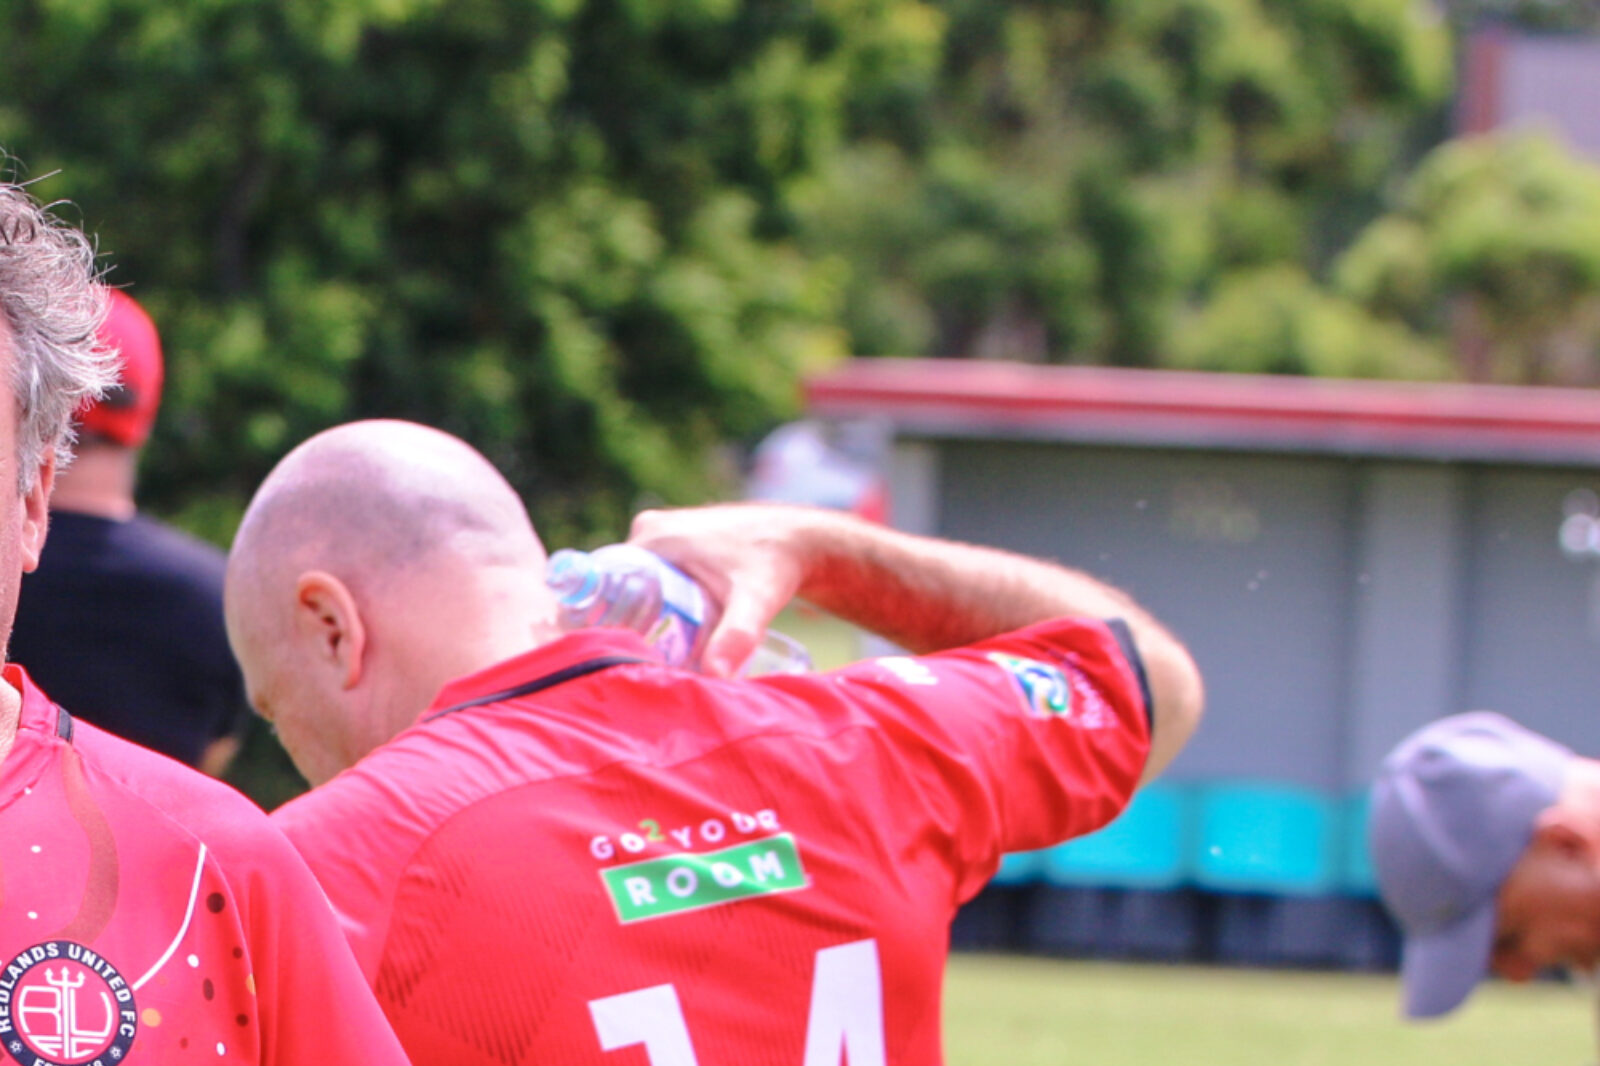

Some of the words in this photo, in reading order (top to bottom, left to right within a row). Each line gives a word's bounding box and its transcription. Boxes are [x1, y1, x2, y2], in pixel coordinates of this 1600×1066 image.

[624, 851, 785, 906] ROOM
[68, 943, 132, 1003] UNITED
[120, 1010, 136, 1038] FC
